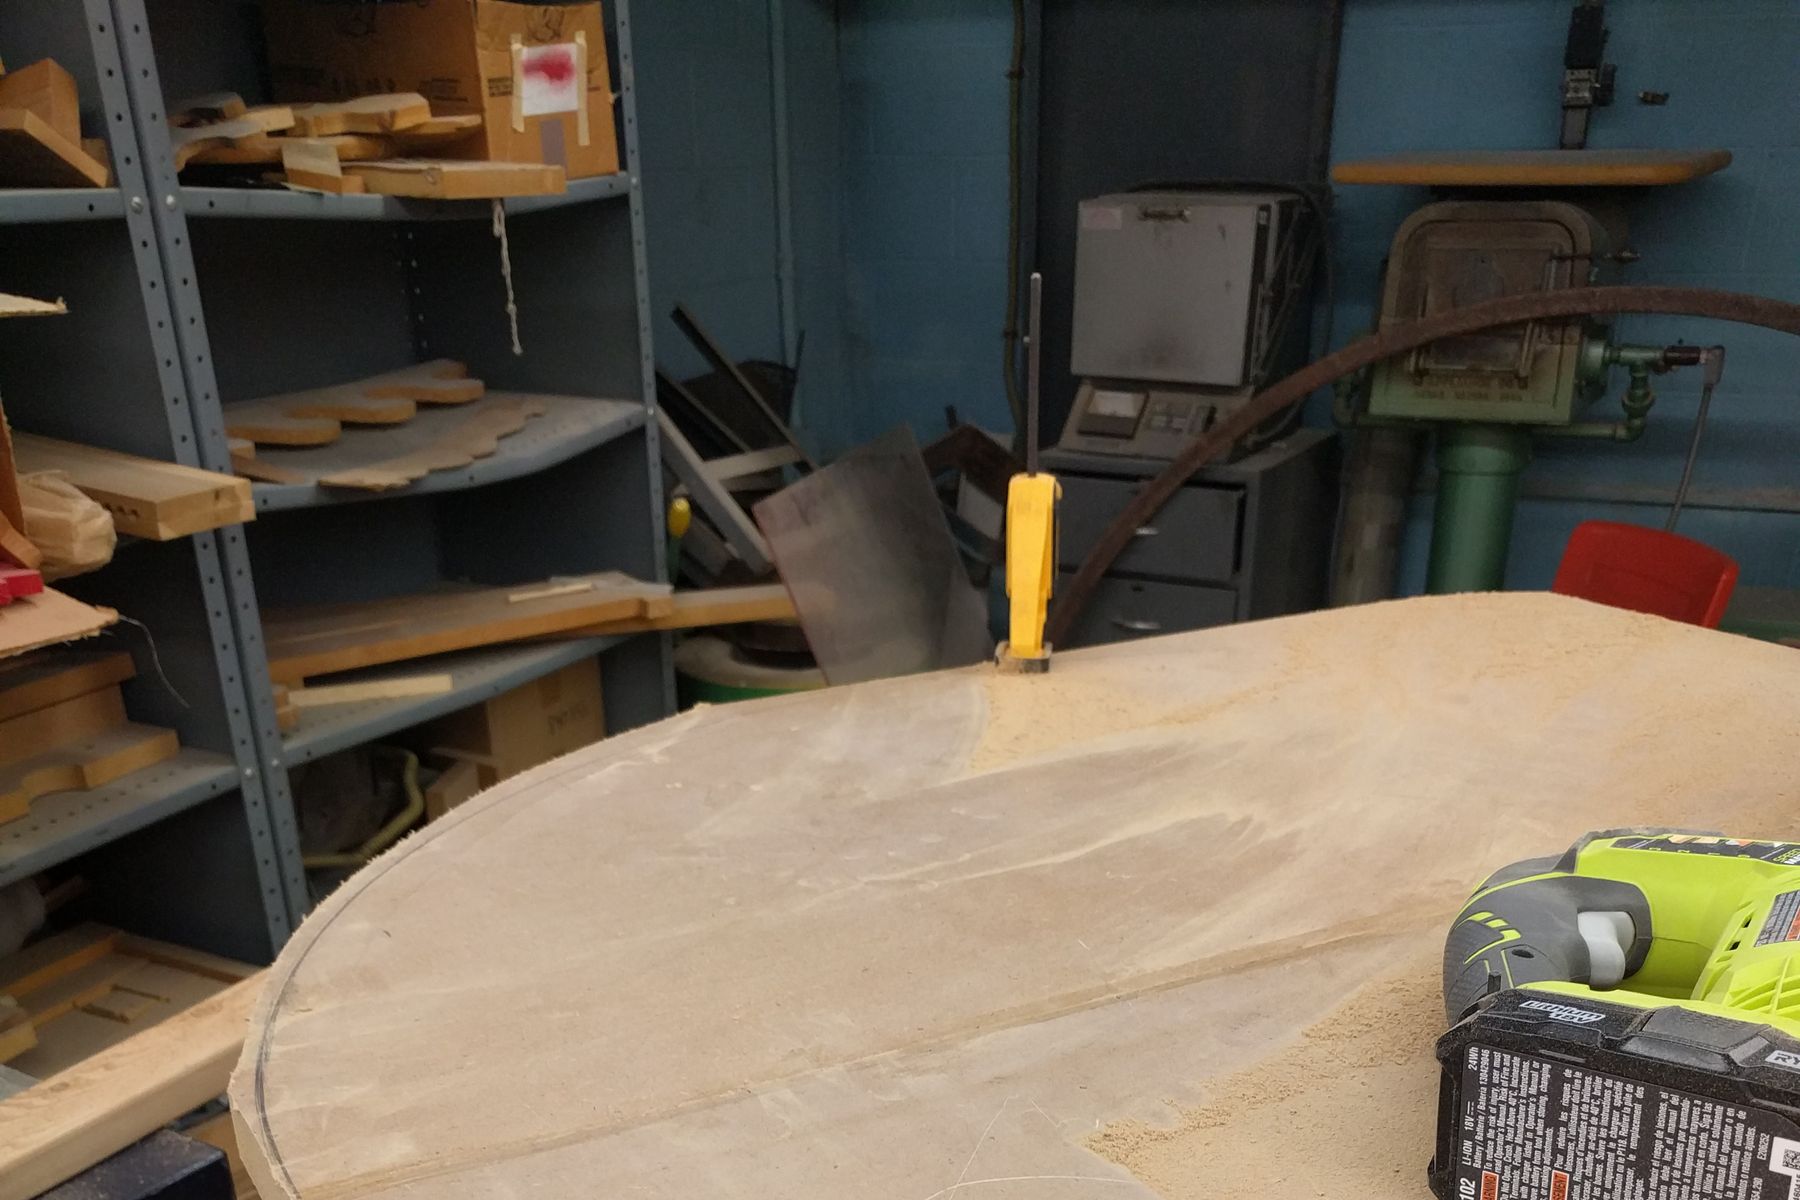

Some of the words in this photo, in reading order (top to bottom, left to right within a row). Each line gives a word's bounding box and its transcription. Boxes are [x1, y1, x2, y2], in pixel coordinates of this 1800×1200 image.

[1469, 1046, 1479, 1071] 24Wh
[1465, 1115, 1474, 1131] 18V
[1462, 1140, 1472, 1166] LI-ION
